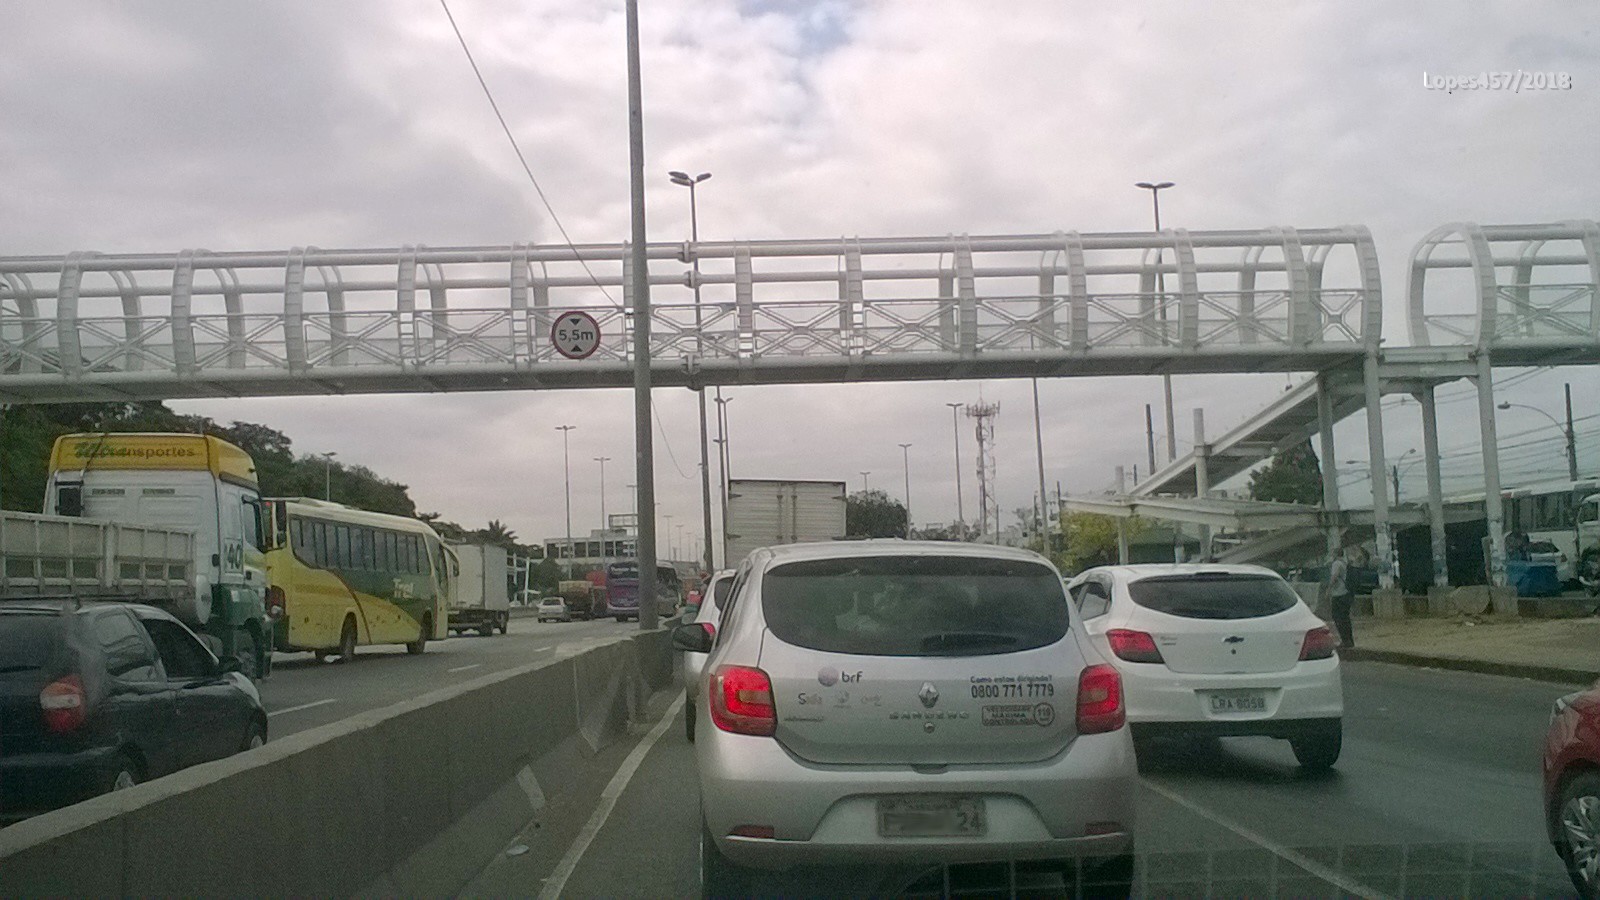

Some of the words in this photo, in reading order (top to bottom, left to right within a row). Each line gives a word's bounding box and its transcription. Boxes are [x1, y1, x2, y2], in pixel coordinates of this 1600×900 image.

[558, 329, 594, 342] 5,5m
[841, 670, 863, 683] brf
[971, 684, 999, 698] 0800
[1002, 683, 1023, 697] 771
[1027, 682, 1054, 697] 7779
